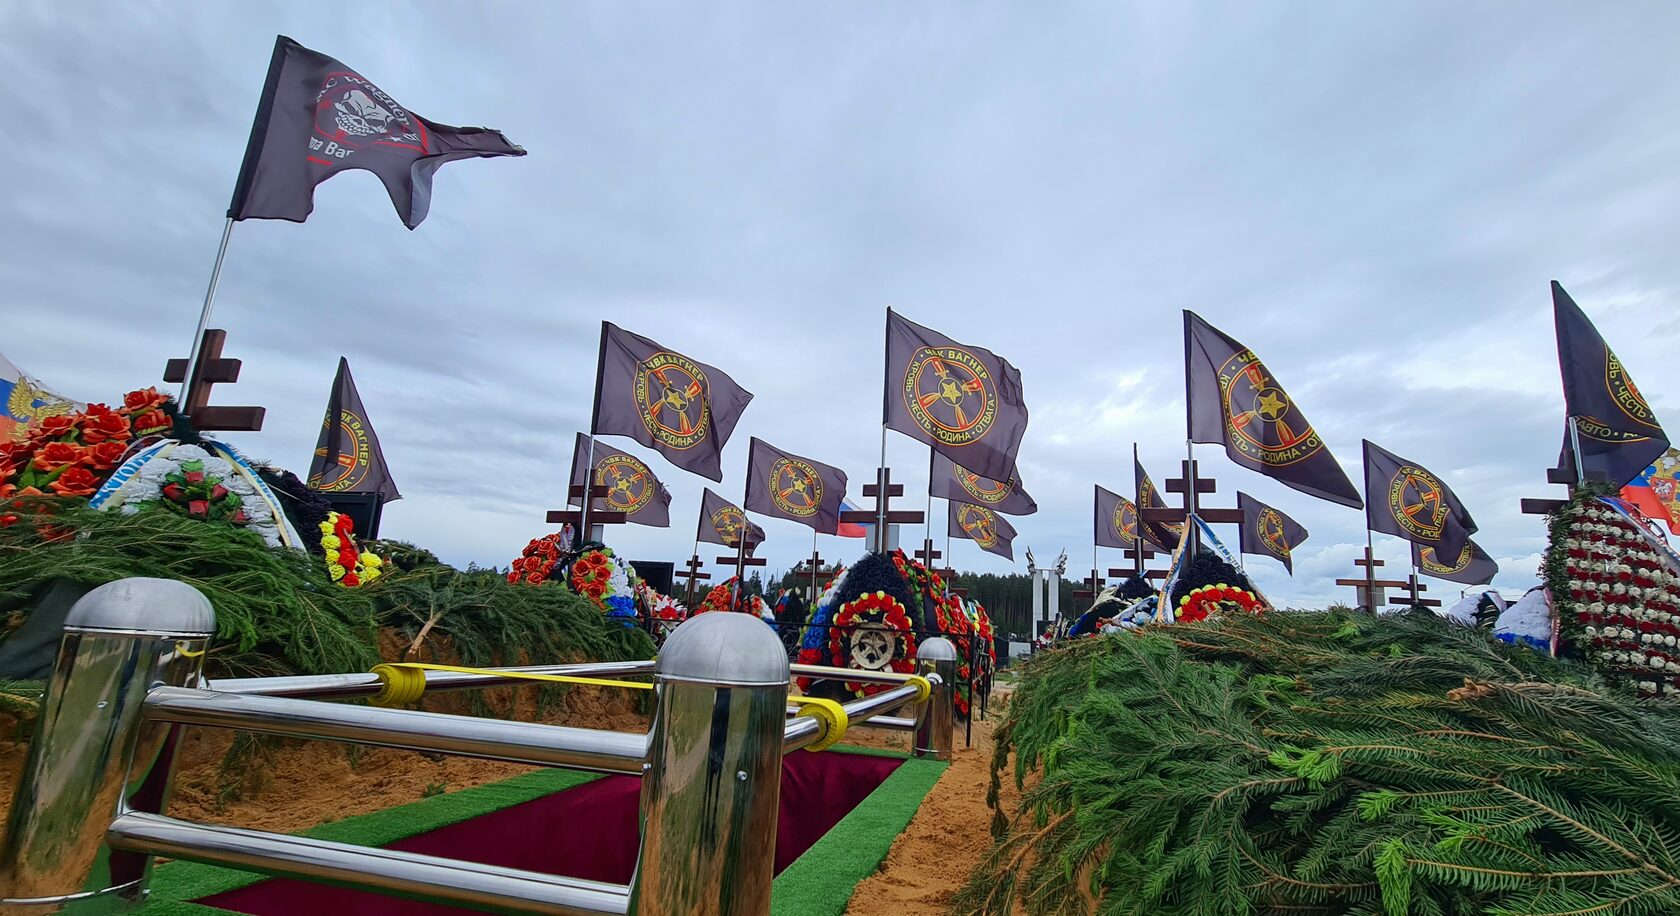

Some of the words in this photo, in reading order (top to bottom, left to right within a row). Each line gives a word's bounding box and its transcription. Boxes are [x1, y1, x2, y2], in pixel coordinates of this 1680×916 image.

[345, 76, 409, 125] Wagner
[646, 355, 667, 369] ЧВК
[666, 355, 705, 381] ВАГНЕР
[905, 361, 920, 392] КРОВЬ
[948, 351, 988, 380] ВАГНЕР
[1609, 353, 1620, 379] ОВЬ
[1616, 386, 1647, 418] ЧЕСТЬ
[636, 371, 645, 403] КРОВЬ
[643, 410, 659, 435] ЧЕСТЬ
[659, 430, 694, 446] РОДИНА
[910, 399, 932, 430] ЧЕСТЬ
[975, 399, 995, 433] ОТВАГА
[351, 421, 369, 466] ВАГНЕР
[936, 429, 972, 442] РОДИНА
[1258, 448, 1302, 464] РОДИНА
[1391, 480, 1403, 506] КРОВЬ
[1395, 509, 1416, 532] ЧЕСТЬ
